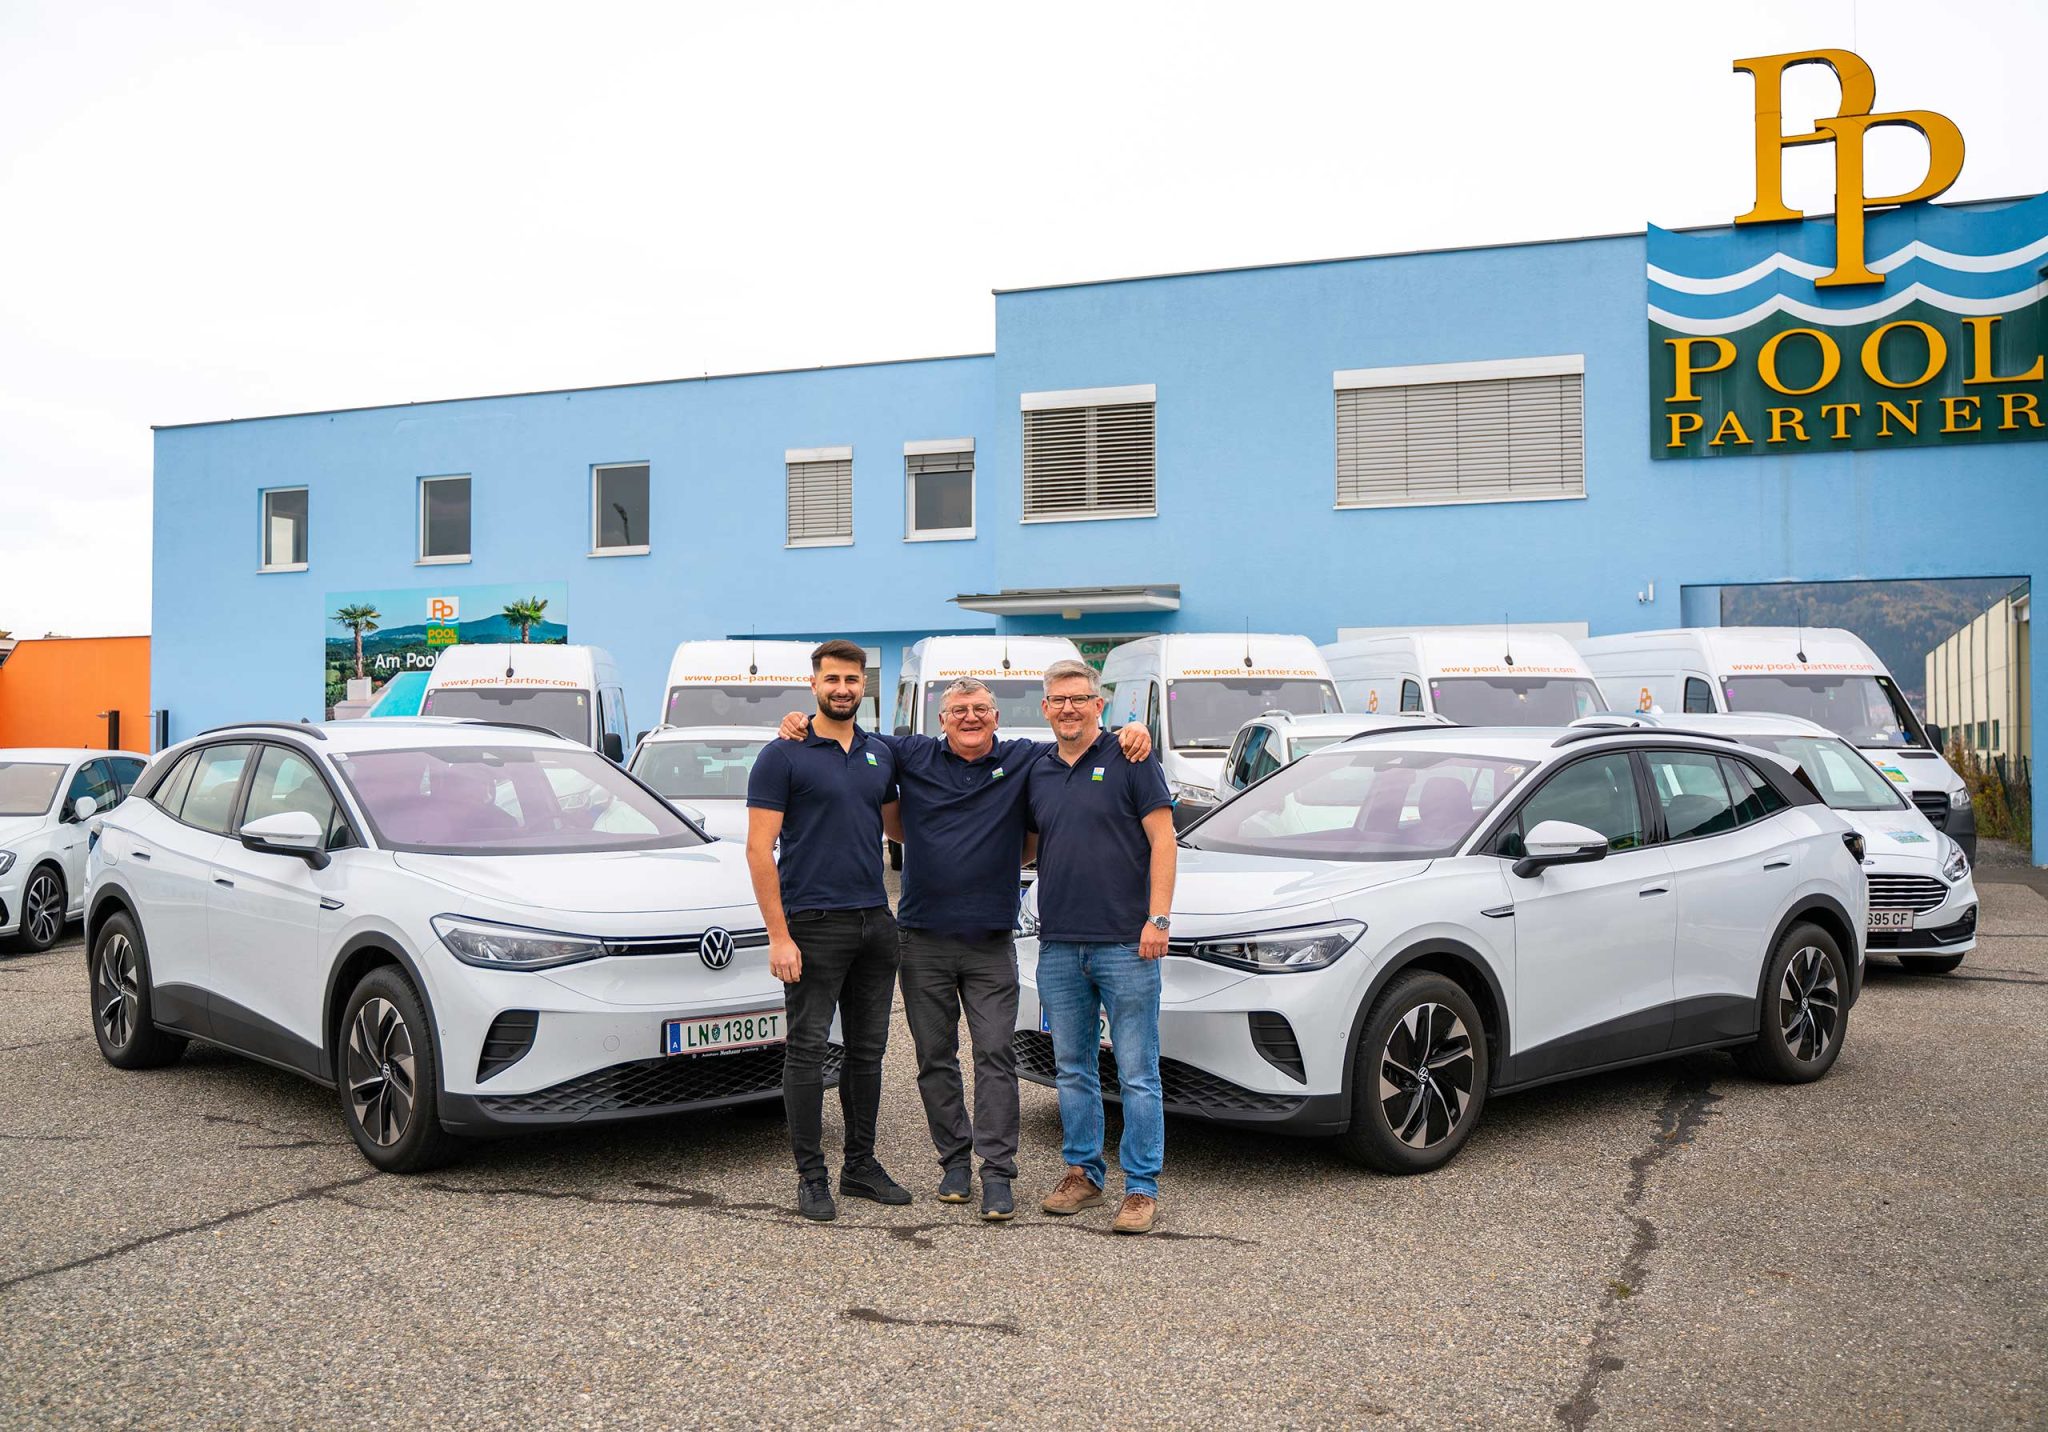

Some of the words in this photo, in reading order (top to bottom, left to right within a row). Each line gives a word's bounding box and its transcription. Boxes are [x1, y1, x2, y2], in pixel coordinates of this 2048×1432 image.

[1664, 316, 2045, 403] POOL
[1666, 393, 2047, 448] PARTNER
[428, 629, 457, 638] POOL
[374, 653, 400, 669] Am
[1731, 662, 1874, 672] www.pool-partner.com
[939, 668, 1045, 677] www.pool-partne
[1182, 667, 1317, 676] www.pool-partner.com
[1441, 665, 1577, 674] www.pool-partner.com
[440, 676, 578, 688] www.pool-partner.com
[1892, 912, 1908, 926] CF
[672, 1041, 679, 1049] A
[687, 1023, 709, 1047] LN
[723, 1018, 754, 1043] 138
[758, 1015, 778, 1038] CT
